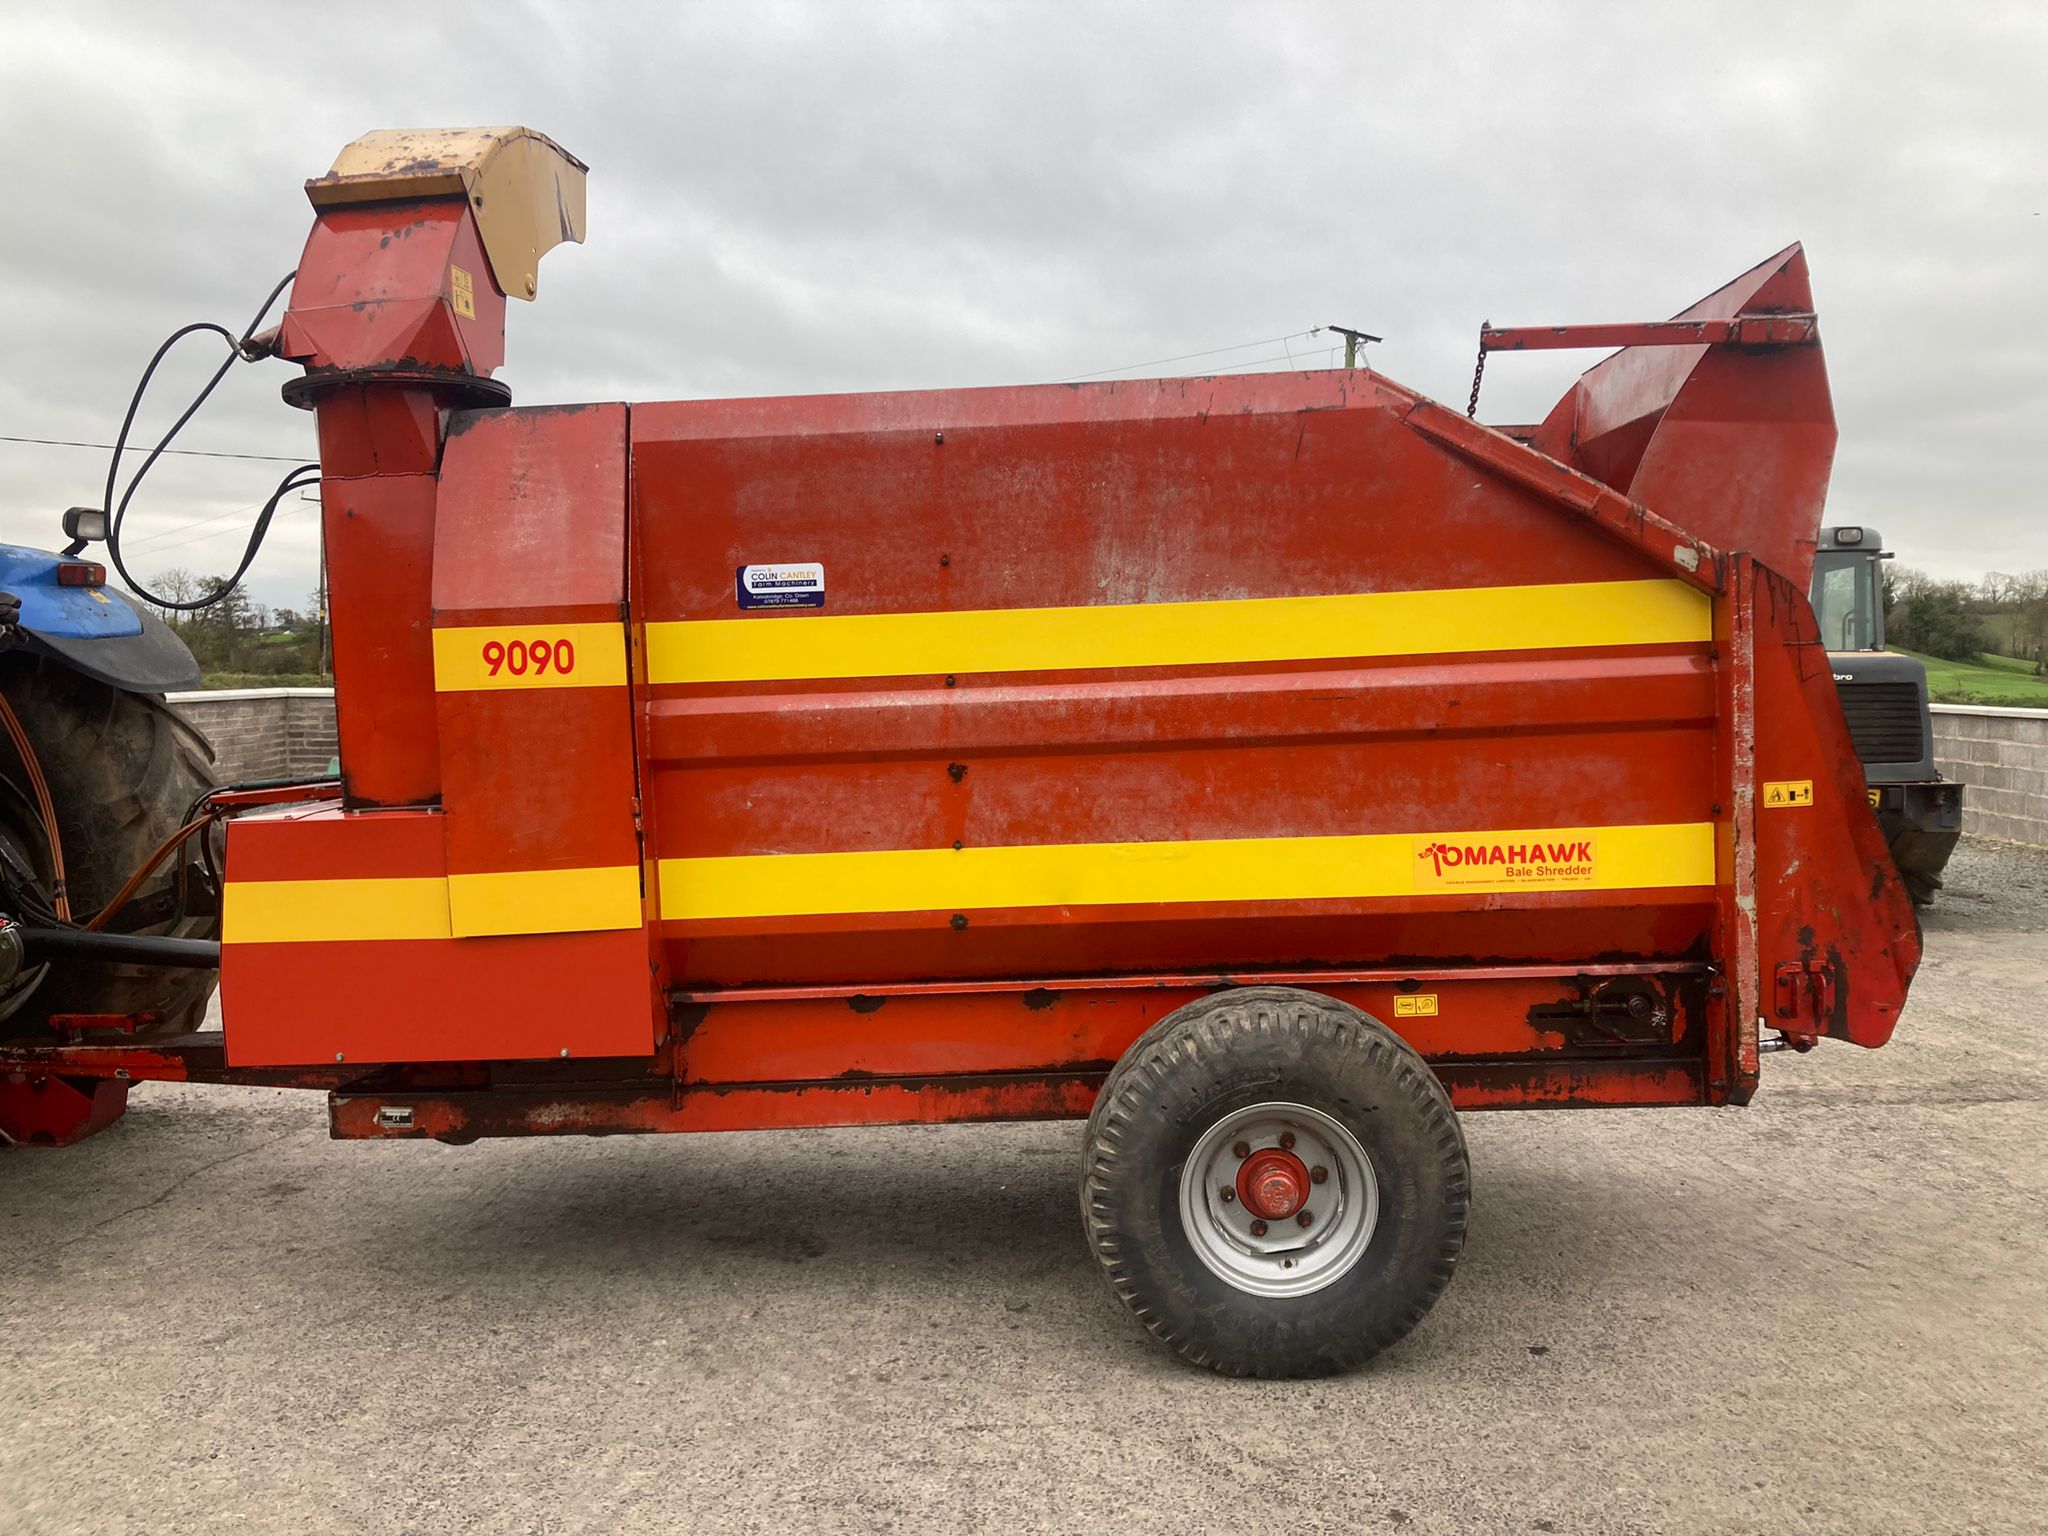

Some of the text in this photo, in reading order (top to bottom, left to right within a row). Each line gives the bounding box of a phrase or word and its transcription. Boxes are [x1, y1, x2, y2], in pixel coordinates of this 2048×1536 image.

[751, 571, 816, 581] COLIN CANTLEY
[482, 639, 574, 676] 9090
[1418, 842, 1592, 877] TOMAHAWK
[1506, 865, 1593, 877] Bale Shredder
